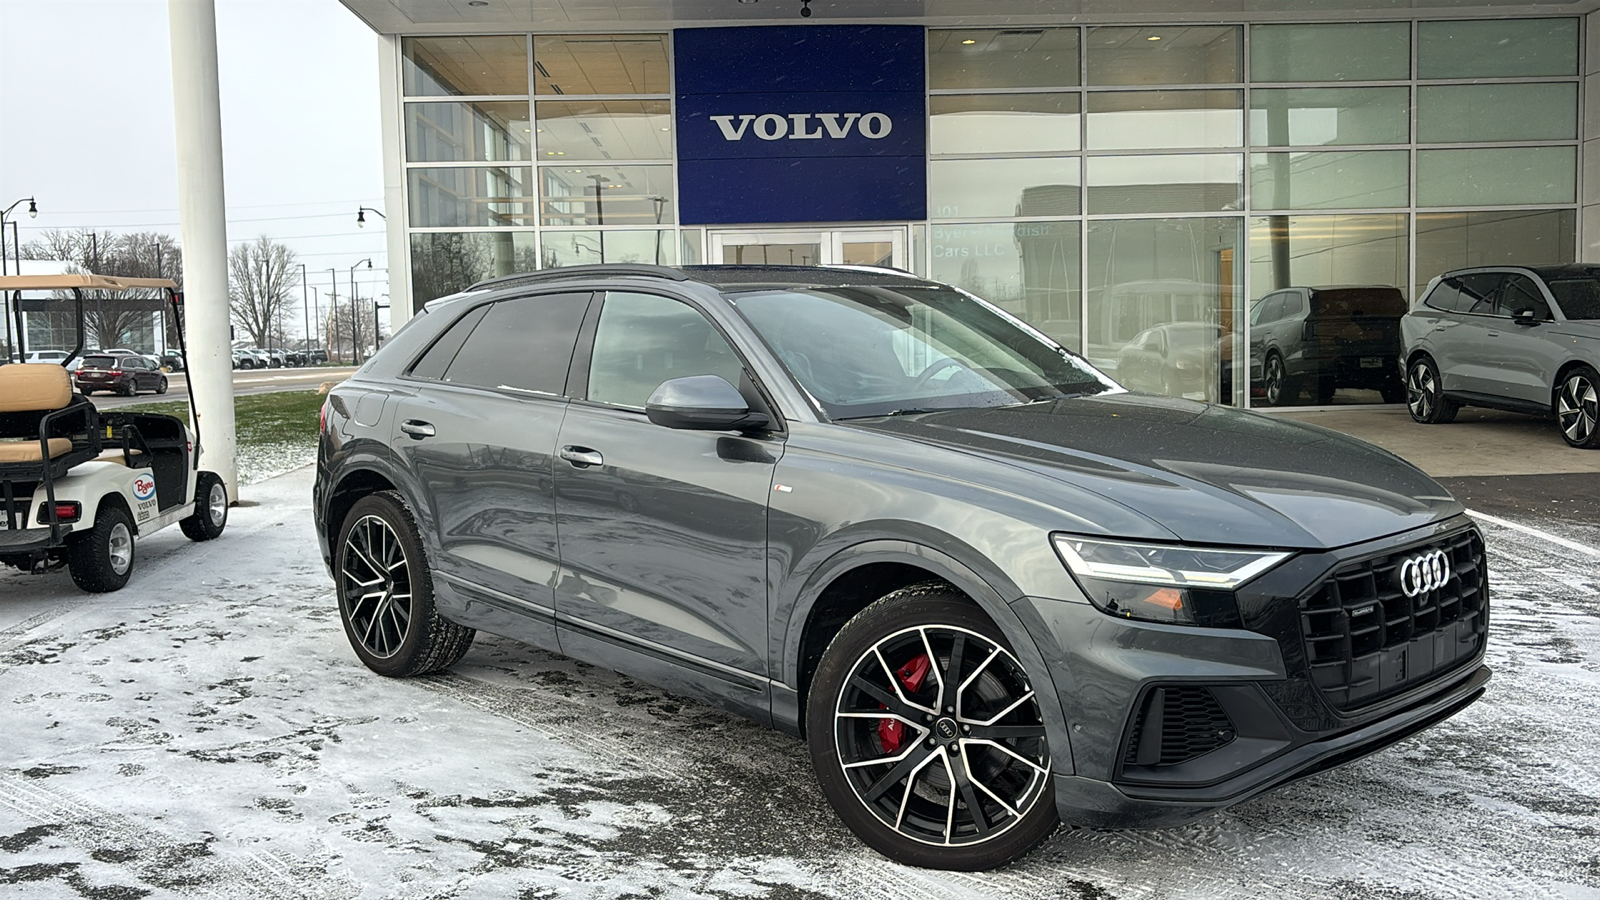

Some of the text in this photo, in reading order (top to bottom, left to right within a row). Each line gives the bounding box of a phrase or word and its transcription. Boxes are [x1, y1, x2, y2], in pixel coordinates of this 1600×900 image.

[709, 112, 893, 141] VOLVO
[934, 243, 1005, 258] Cars LLC
[137, 499, 156, 510] VOLVO
